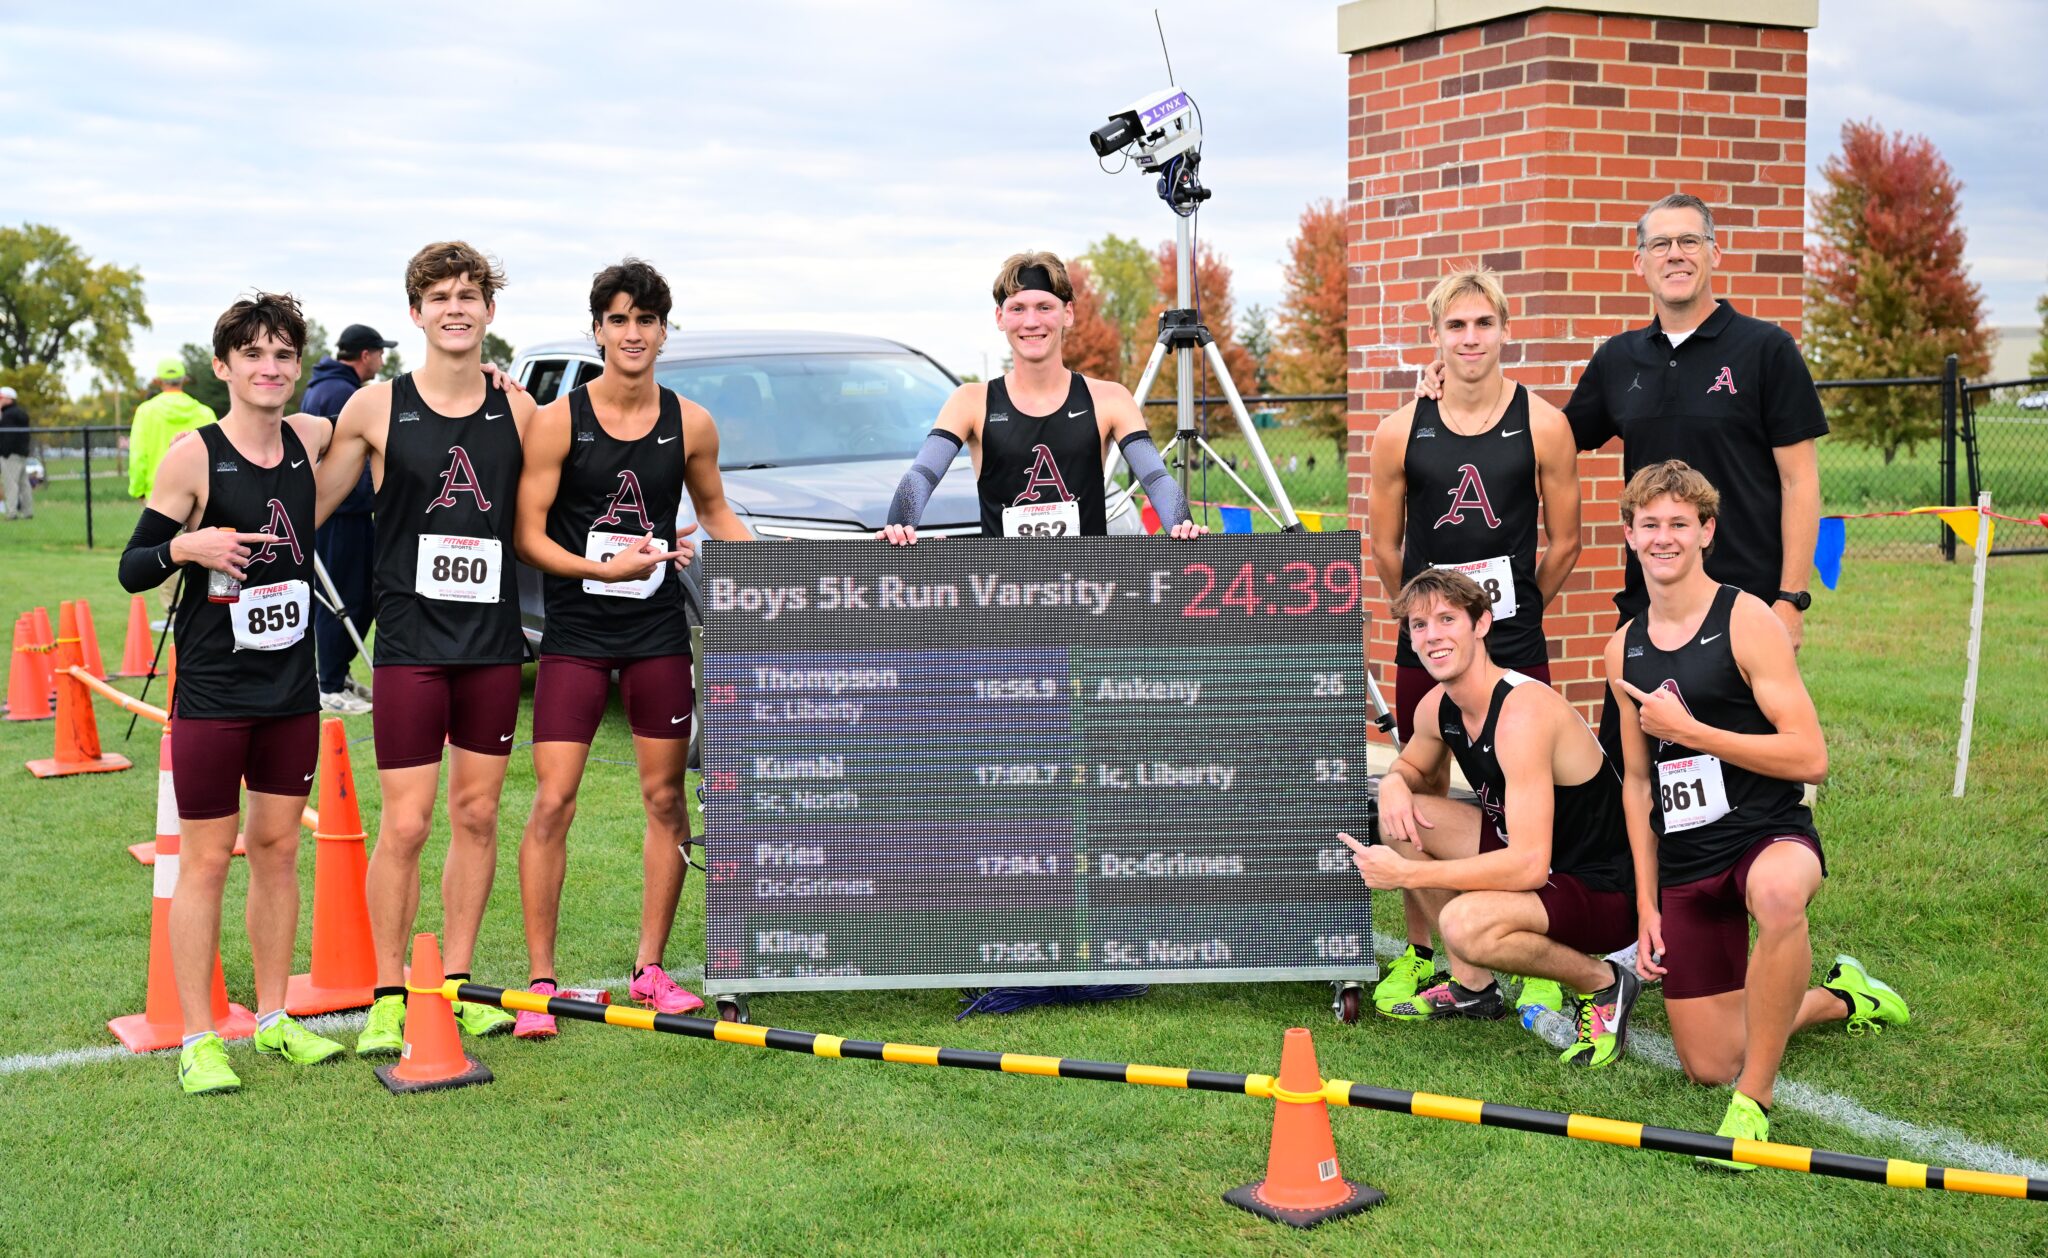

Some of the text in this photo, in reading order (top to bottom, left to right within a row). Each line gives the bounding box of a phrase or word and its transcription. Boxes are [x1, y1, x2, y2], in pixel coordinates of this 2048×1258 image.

[1152, 98, 1181, 118] LYNX
[1706, 366, 1737, 395] A
[423, 445, 492, 514] A
[1013, 444, 1075, 506] A
[590, 469, 655, 531] A
[1434, 464, 1501, 529] A
[1023, 504, 1057, 513] FITNESS
[243, 498, 304, 568] A
[443, 537, 480, 546] FITNESS
[432, 555, 488, 584] 860
[1453, 561, 1488, 571] FITNESS
[252, 583, 289, 597] FITNESS
[710, 577, 807, 619] Boys
[818, 576, 869, 608] 5k
[879, 576, 958, 608] Run
[970, 573, 1116, 614] Varsity
[1152, 571, 1171, 603] F
[1182, 560, 1360, 616] 24:39
[248, 601, 300, 634] 859
[754, 667, 899, 693] Thompson
[1072, 679, 1083, 697] 1
[1097, 677, 1201, 705] Ankeny
[786, 700, 863, 724] Liberty
[755, 755, 845, 778] Kumbi
[1073, 765, 1086, 783] 2
[1136, 763, 1236, 789] Liberty
[1314, 759, 1346, 781] 52
[1662, 760, 1693, 771] FITNESS
[794, 789, 858, 809] North
[1662, 778, 1707, 813] 861
[755, 844, 824, 865] Pries
[1076, 855, 1088, 873] 3
[1099, 853, 1244, 876] Dc-Grimes
[1317, 849, 1350, 871] 65
[712, 861, 739, 880] 27
[757, 878, 875, 897] Dc-Grimes
[757, 929, 828, 958] Kling
[1076, 942, 1089, 961] 4
[1147, 939, 1232, 962] North
[1314, 935, 1360, 958] 105
